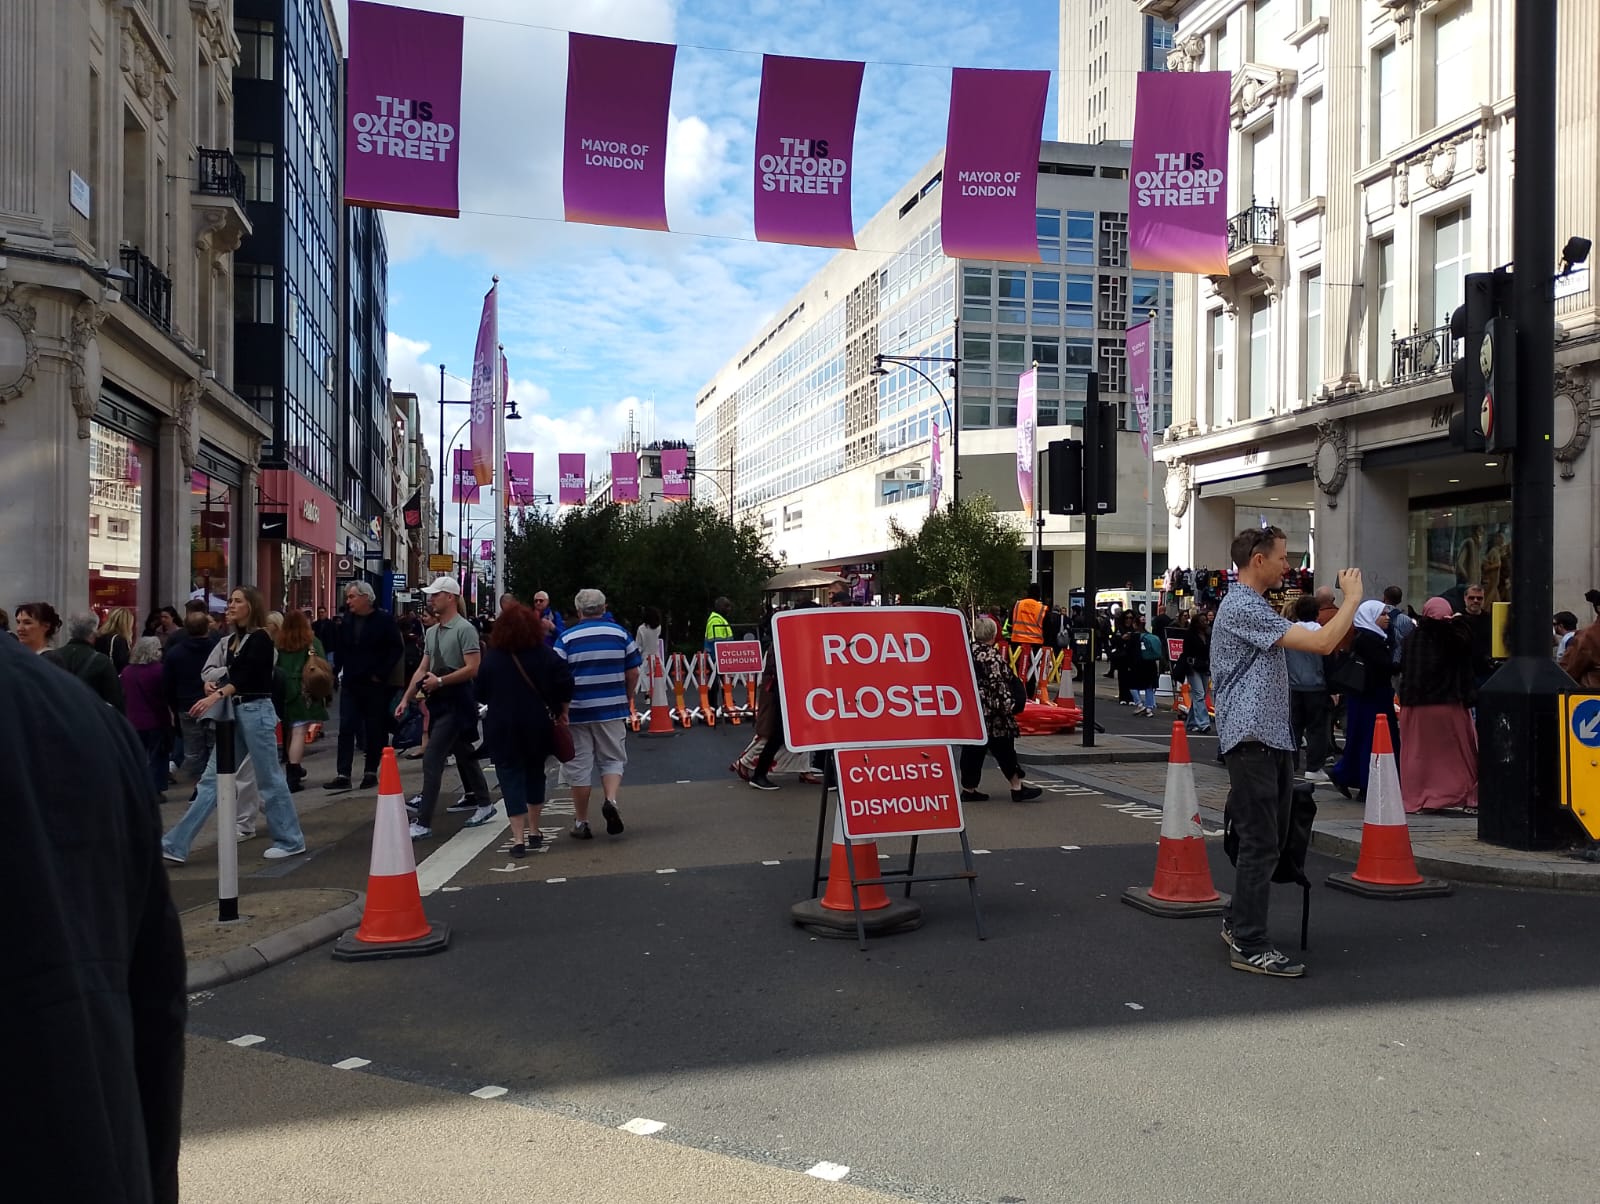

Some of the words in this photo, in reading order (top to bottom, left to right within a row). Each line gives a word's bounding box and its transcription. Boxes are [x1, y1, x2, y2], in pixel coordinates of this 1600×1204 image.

[376, 95, 433, 121] THIS
[353, 112, 455, 143] OXFORD
[357, 133, 450, 162] STREET
[581, 138, 628, 155] MAYOR
[630, 144, 649, 156] OF
[780, 137, 829, 158] THIS
[585, 153, 644, 171] LONDON
[759, 154, 847, 177] OXFORD
[1155, 152, 1204, 171] THIS
[762, 173, 843, 195] STREET
[959, 171, 1002, 183] MAYOR
[1004, 171, 1021, 183] OF
[1134, 168, 1224, 189] OXFORD
[962, 185, 1016, 197] LONDON
[1137, 186, 1220, 207] STREET
[822, 633, 931, 665] ROAD
[720, 657, 758, 665] DISMOUNT
[805, 685, 963, 721] CLOSED
[849, 763, 943, 783] CYCLISTS
[850, 794, 950, 817] DISMOUNT
